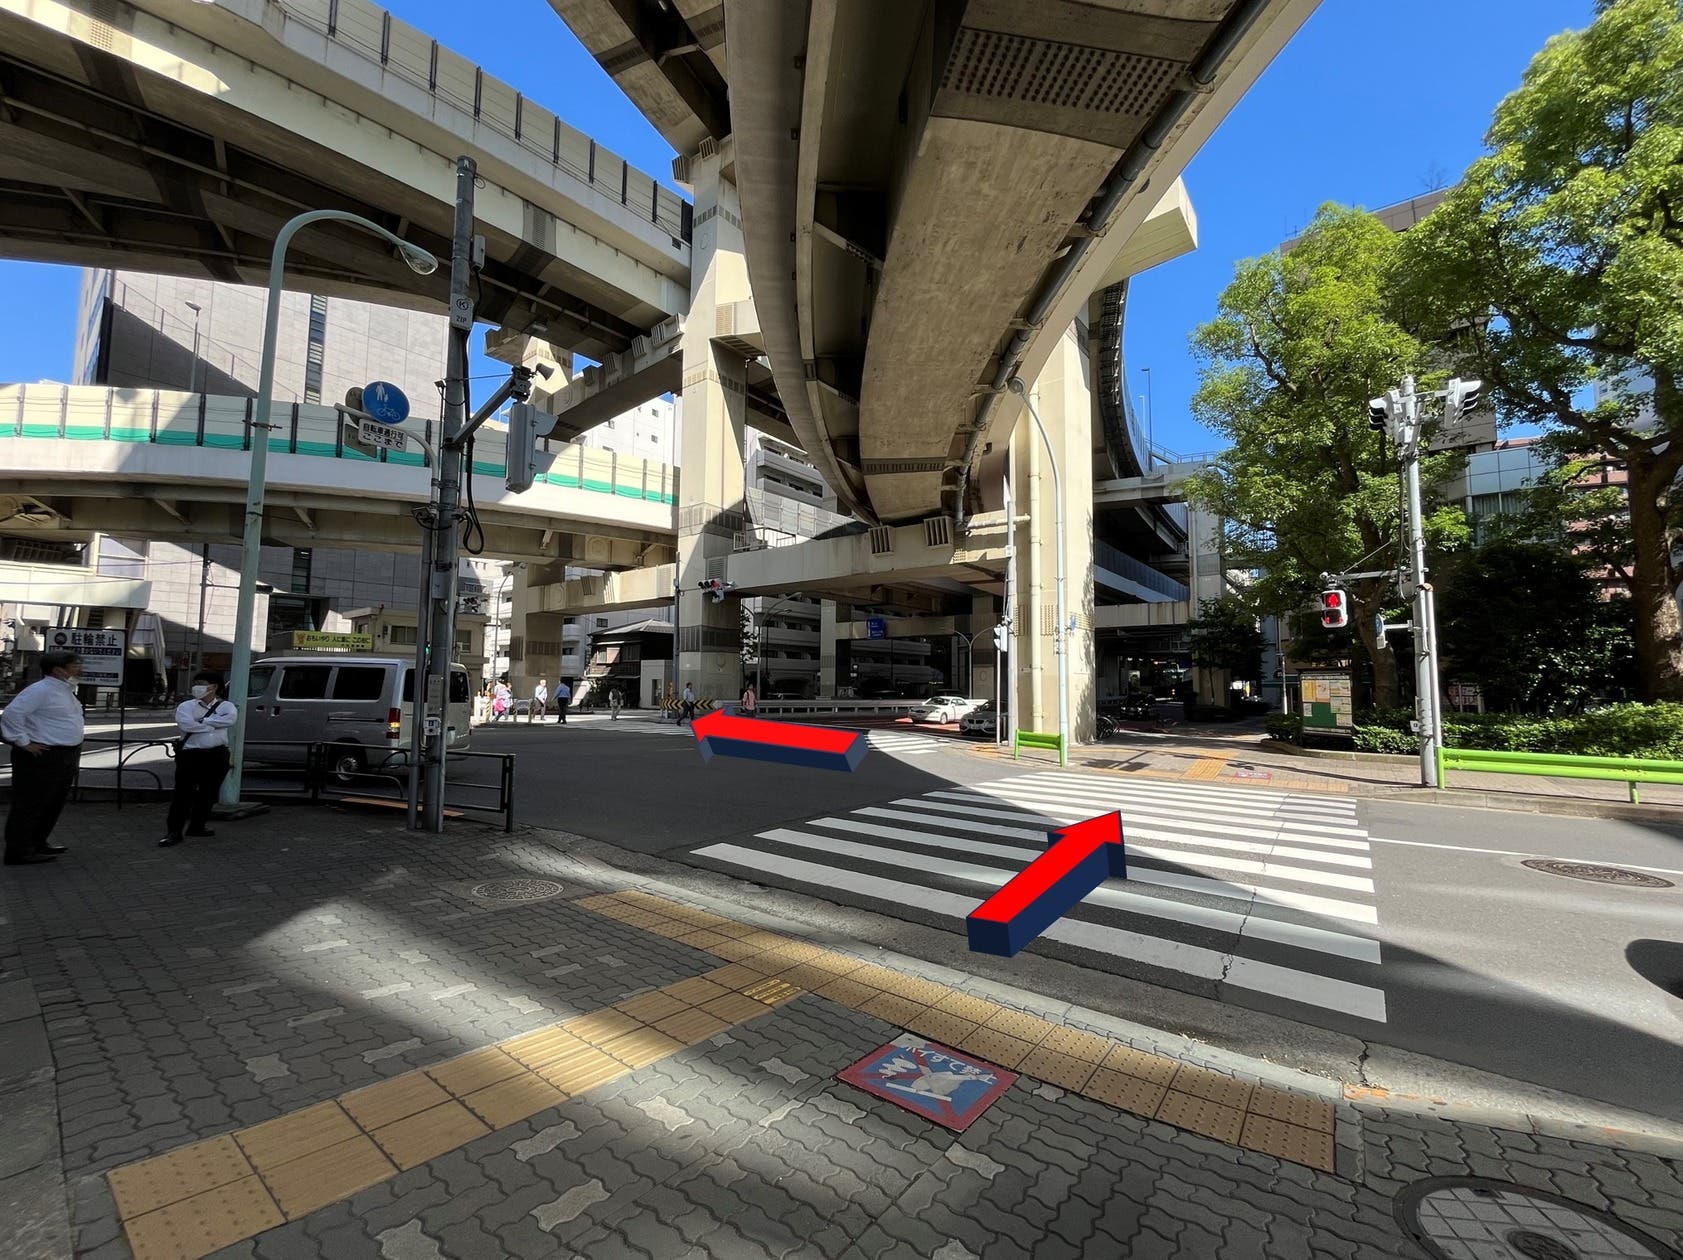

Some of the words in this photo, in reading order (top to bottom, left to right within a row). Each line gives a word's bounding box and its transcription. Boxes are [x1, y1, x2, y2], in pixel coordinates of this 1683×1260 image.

[363, 423, 404, 440] 自転車通行可
[362, 432, 403, 449] ここまで
[71, 632, 118, 647] 駐輪禁止
